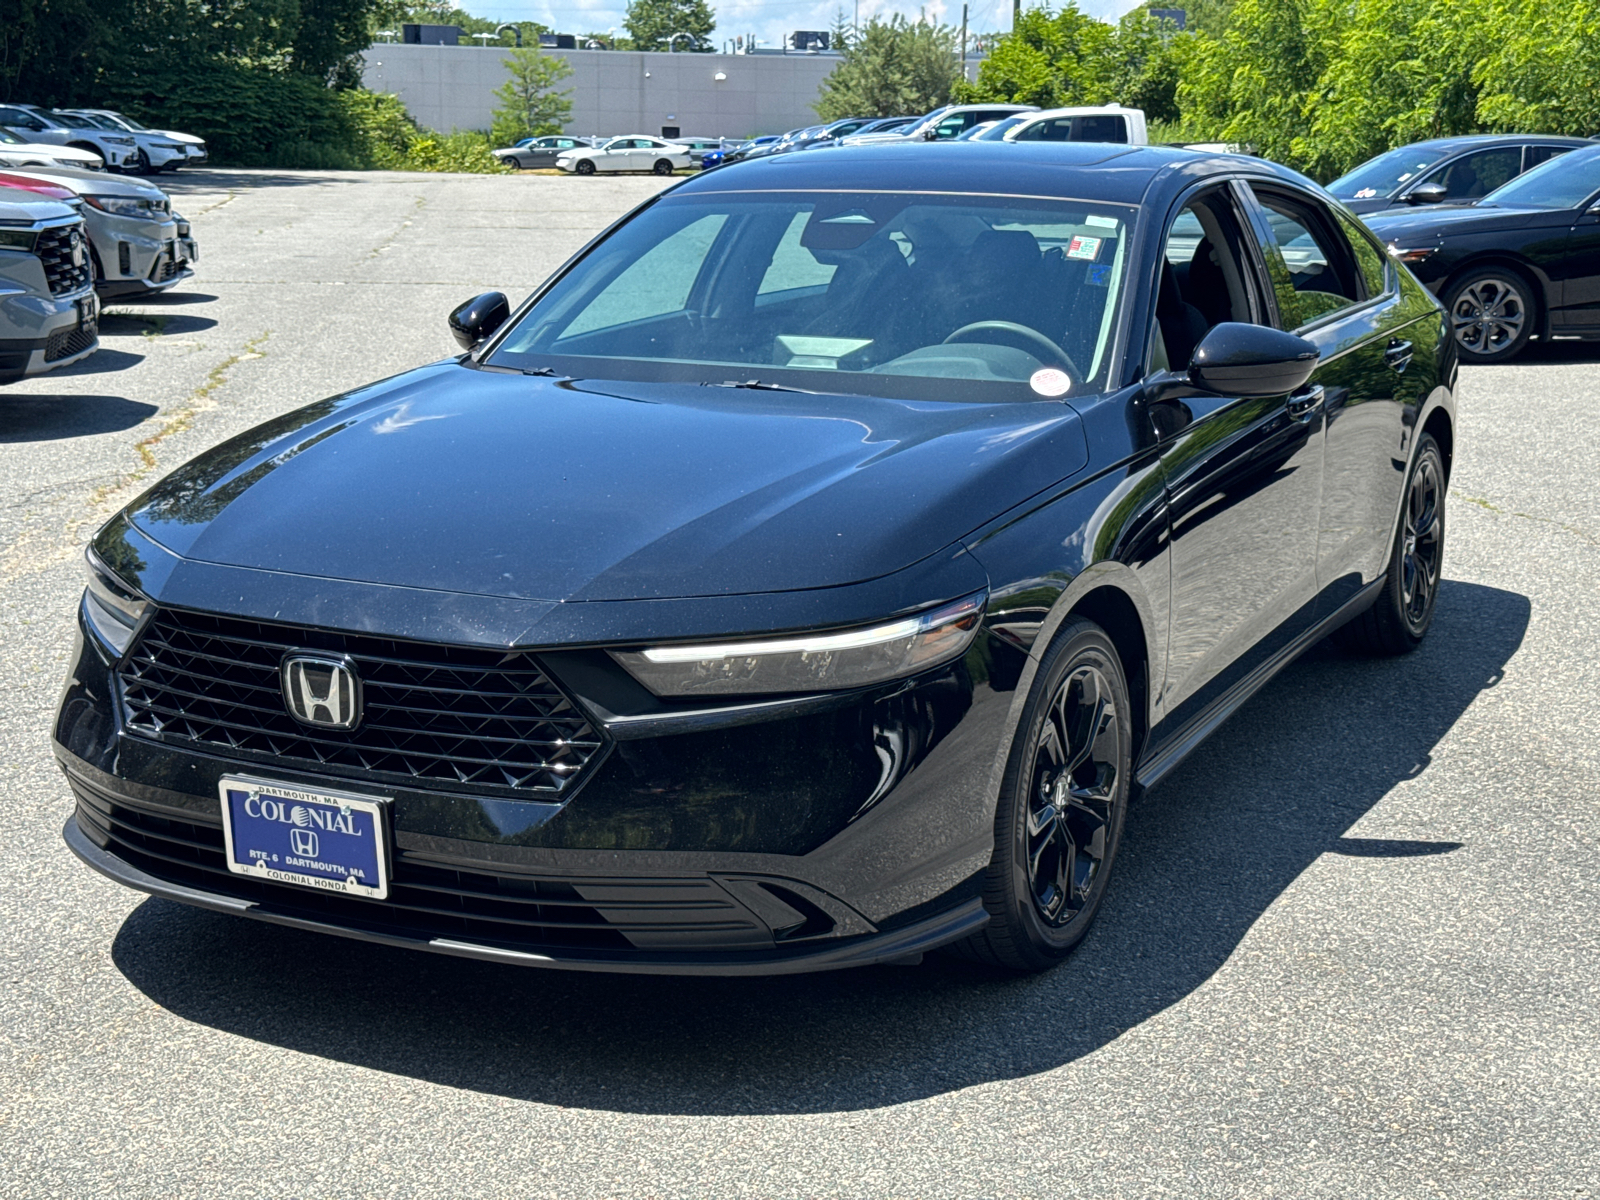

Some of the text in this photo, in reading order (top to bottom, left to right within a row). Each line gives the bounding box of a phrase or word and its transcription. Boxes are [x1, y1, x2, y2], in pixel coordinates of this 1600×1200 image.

[323, 797, 339, 806] MA
[244, 797, 362, 836] COLONIAL
[249, 849, 365, 878] RTE. 6 DARTMOUTH, MA
[266, 870, 348, 892] COLONIAL HONDA
